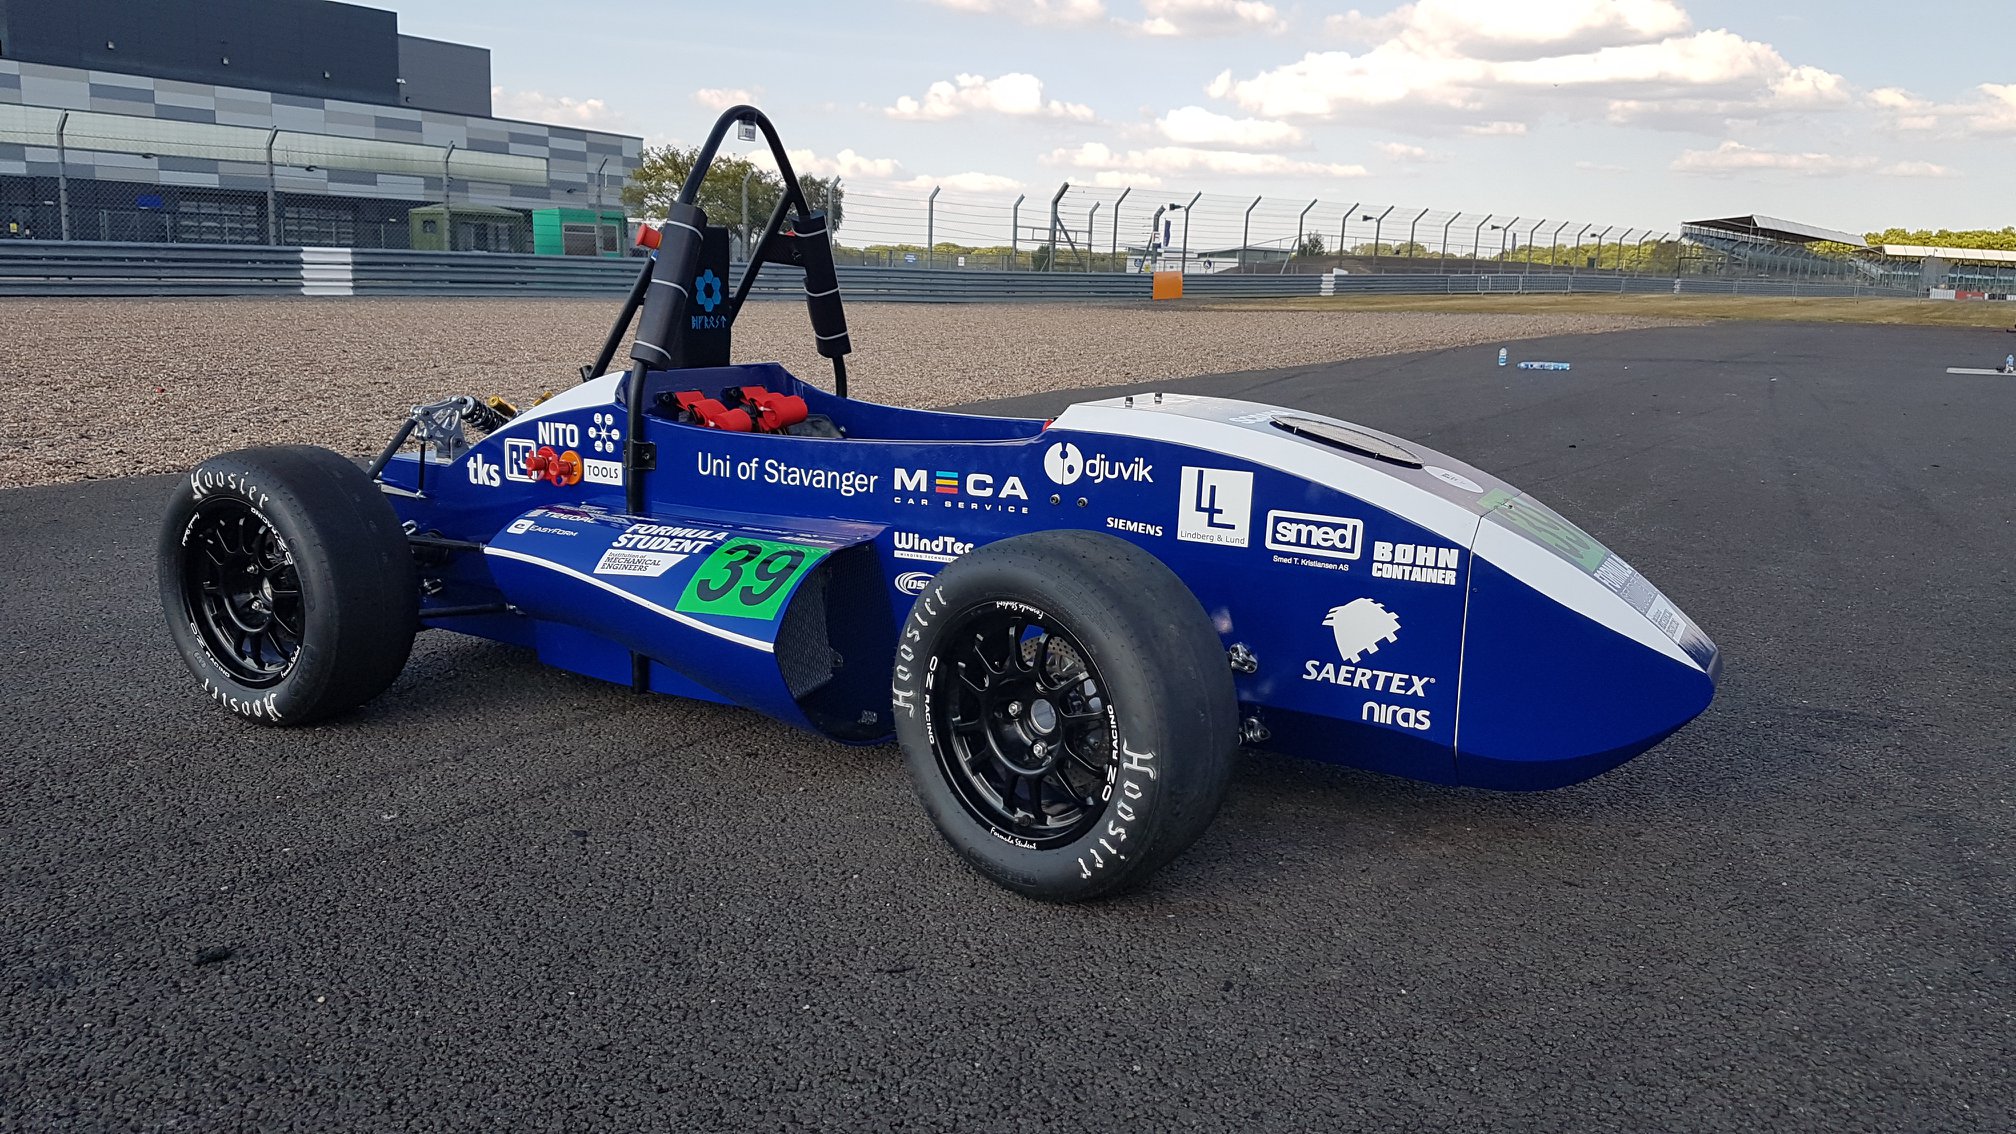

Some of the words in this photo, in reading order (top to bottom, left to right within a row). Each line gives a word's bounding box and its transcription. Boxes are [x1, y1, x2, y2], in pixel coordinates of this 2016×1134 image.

[538, 421, 579, 448] NITO
[467, 453, 500, 487] tks
[586, 464, 619, 480] TOOLS
[697, 451, 731, 477] Uni
[737, 457, 759, 480] of
[764, 459, 879, 496] Stavanger
[1085, 453, 1154, 484] djuvik
[893, 497, 929, 506] CAR
[944, 500, 1029, 514] SERVICE
[625, 523, 729, 541] FORMULA
[1106, 516, 1163, 537] SIEMENS
[1180, 531, 1214, 543] Lindberg
[1216, 535, 1224, 543] &
[1225, 536, 1246, 545] Lund
[1276, 523, 1352, 547] smed
[612, 533, 713, 553] STUDENT
[1373, 540, 1459, 569] BØHN
[600, 563, 650, 572] ENGINEERS
[604, 557, 662, 566] MECHANICAL
[696, 541, 806, 606] 39
[1301, 559, 1337, 569] Kristiansen
[1338, 563, 1349, 571] AS
[907, 579, 930, 590] DS
[1371, 562, 1457, 586] CONTAINER
[924, 694, 935, 745] RACING
[1361, 701, 1431, 731] niras
[1106, 704, 1118, 760] RACING
